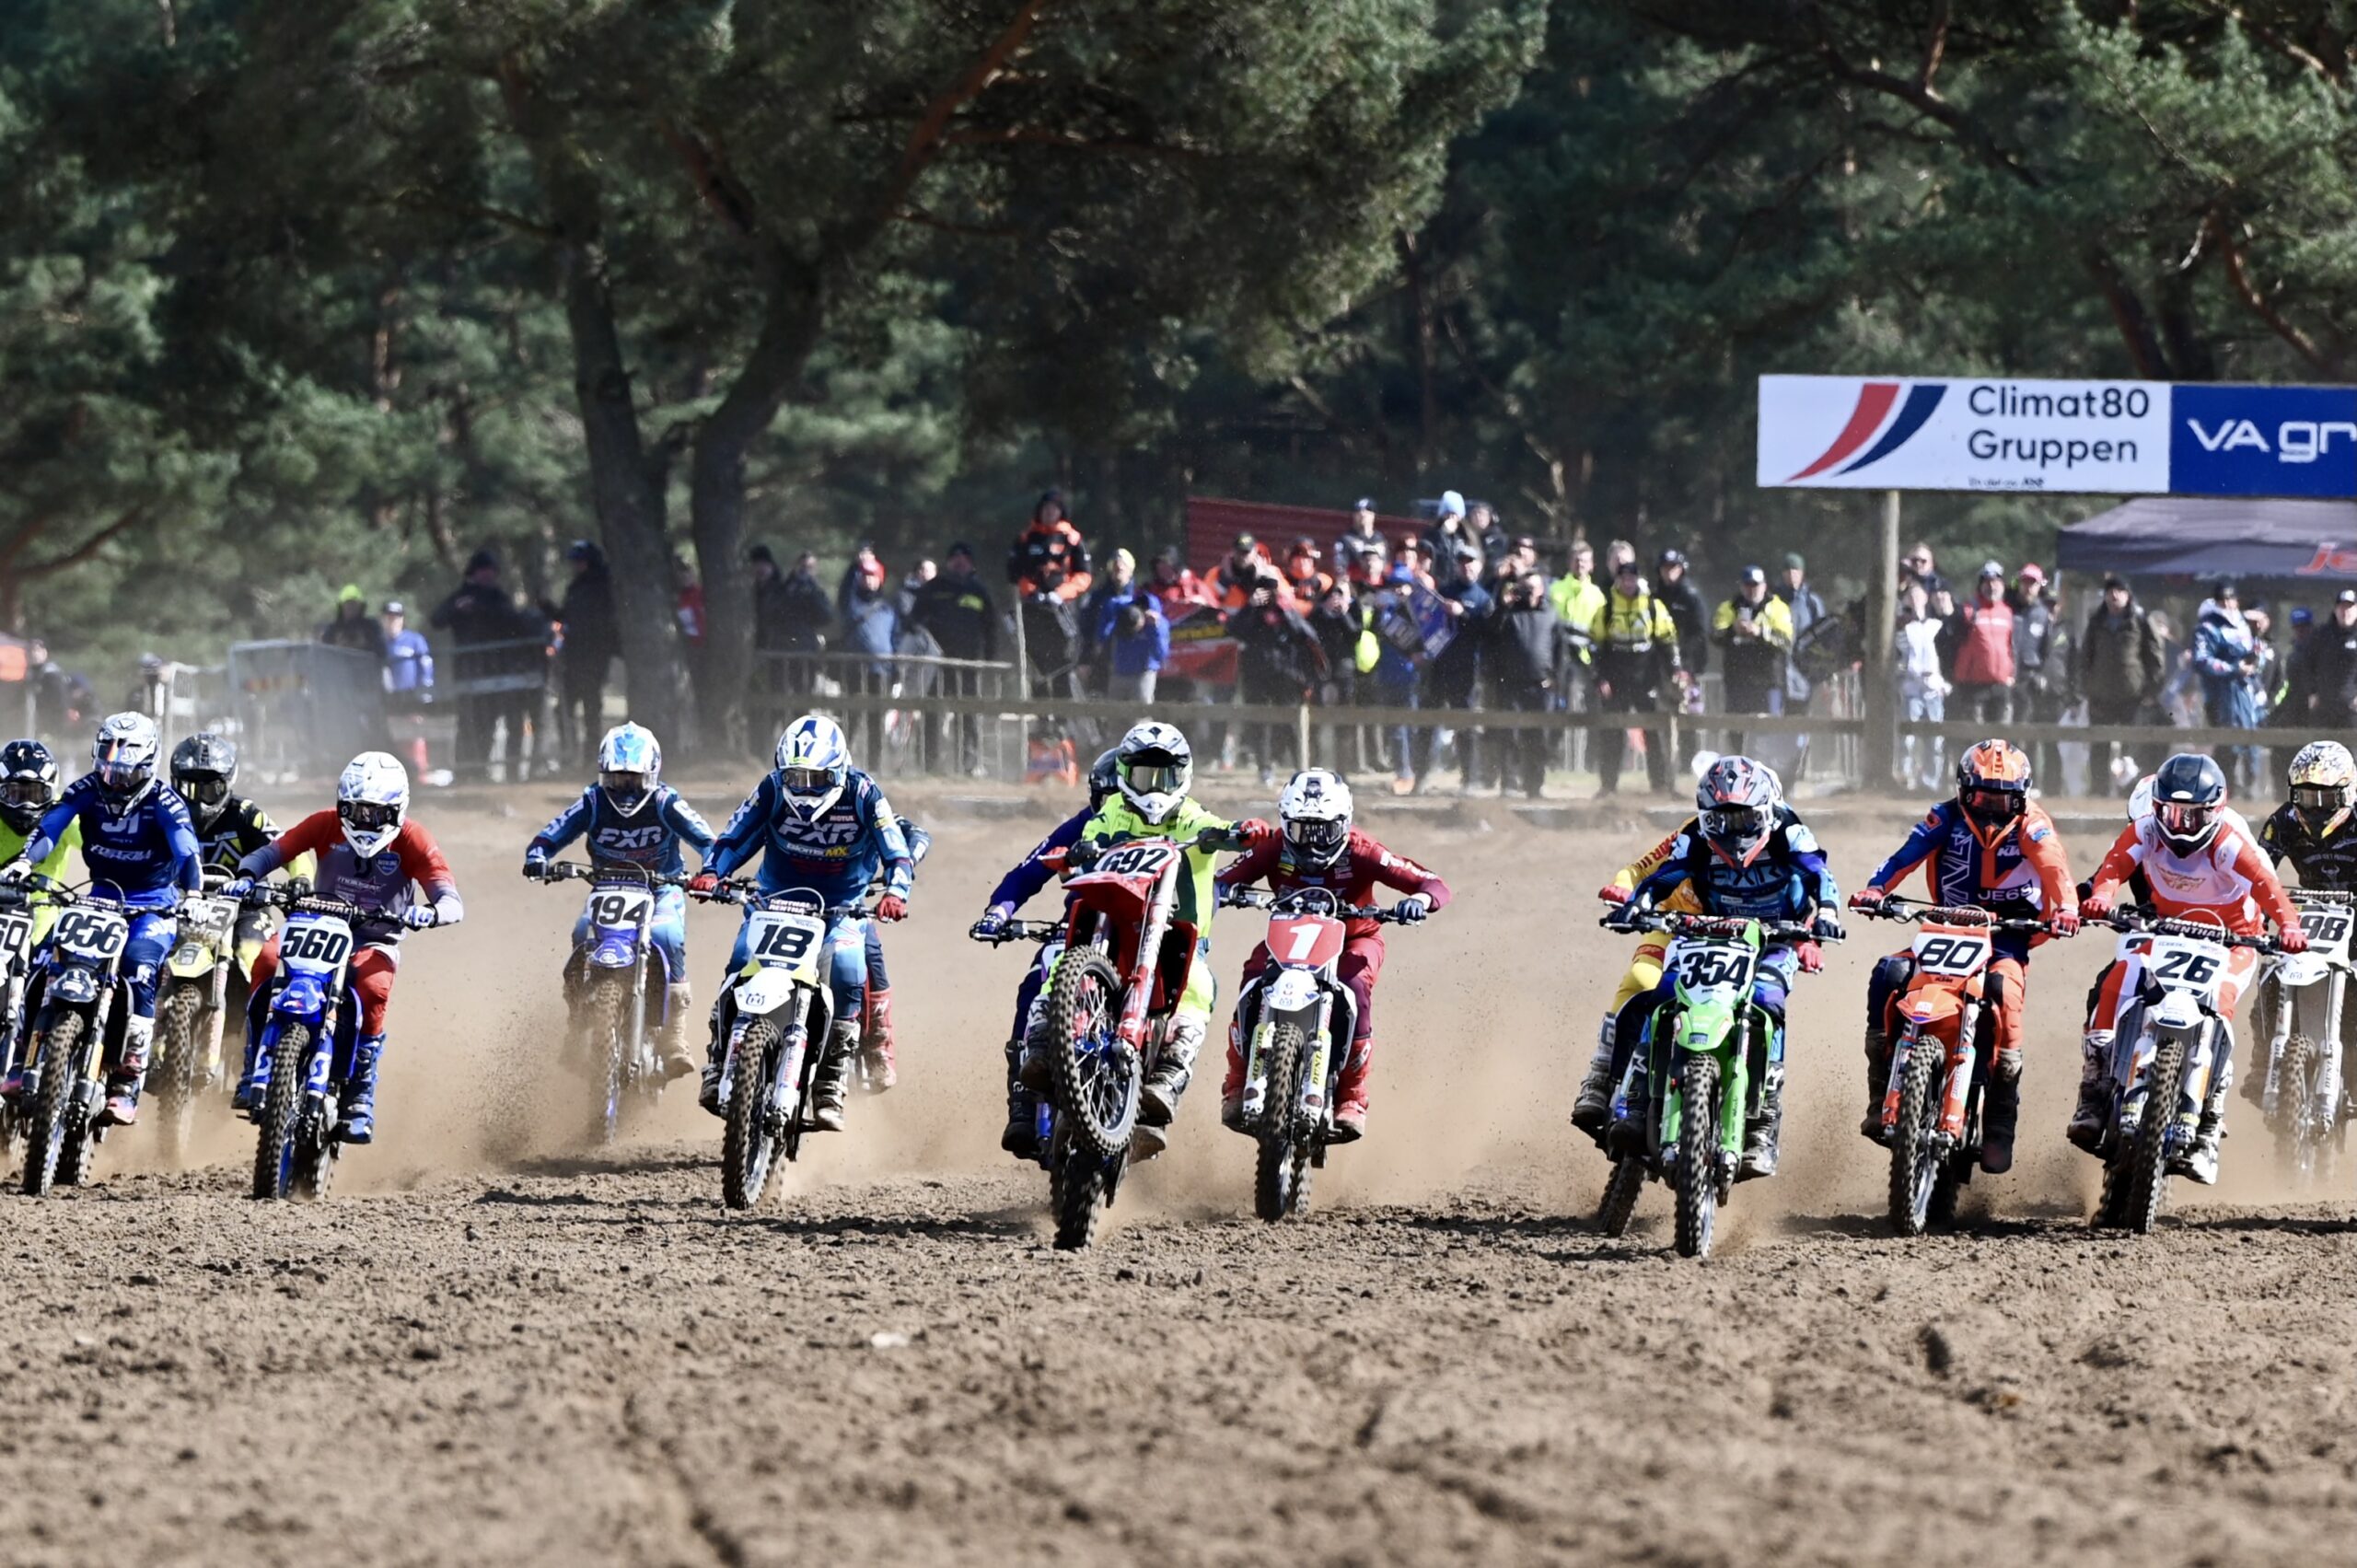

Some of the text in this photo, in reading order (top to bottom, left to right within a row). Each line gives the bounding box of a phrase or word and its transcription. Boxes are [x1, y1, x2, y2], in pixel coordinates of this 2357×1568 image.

[1968, 385, 2150, 419] Climat80
[1968, 429, 2138, 469] Gruppen
[2187, 418, 2270, 452] VA
[597, 826, 662, 848] FXR
[778, 817, 859, 844] FXR
[1100, 848, 1168, 875] 692
[590, 895, 650, 928] 194
[2296, 915, 2349, 942] 98
[57, 912, 128, 955] 956
[281, 926, 349, 964] 560
[754, 923, 815, 959] 18
[1287, 923, 1323, 960] 1
[1679, 950, 1751, 991] 354
[1916, 937, 1984, 970] 80
[2154, 950, 2221, 984] 26
[1312, 1035, 1323, 1086] DUNLP
